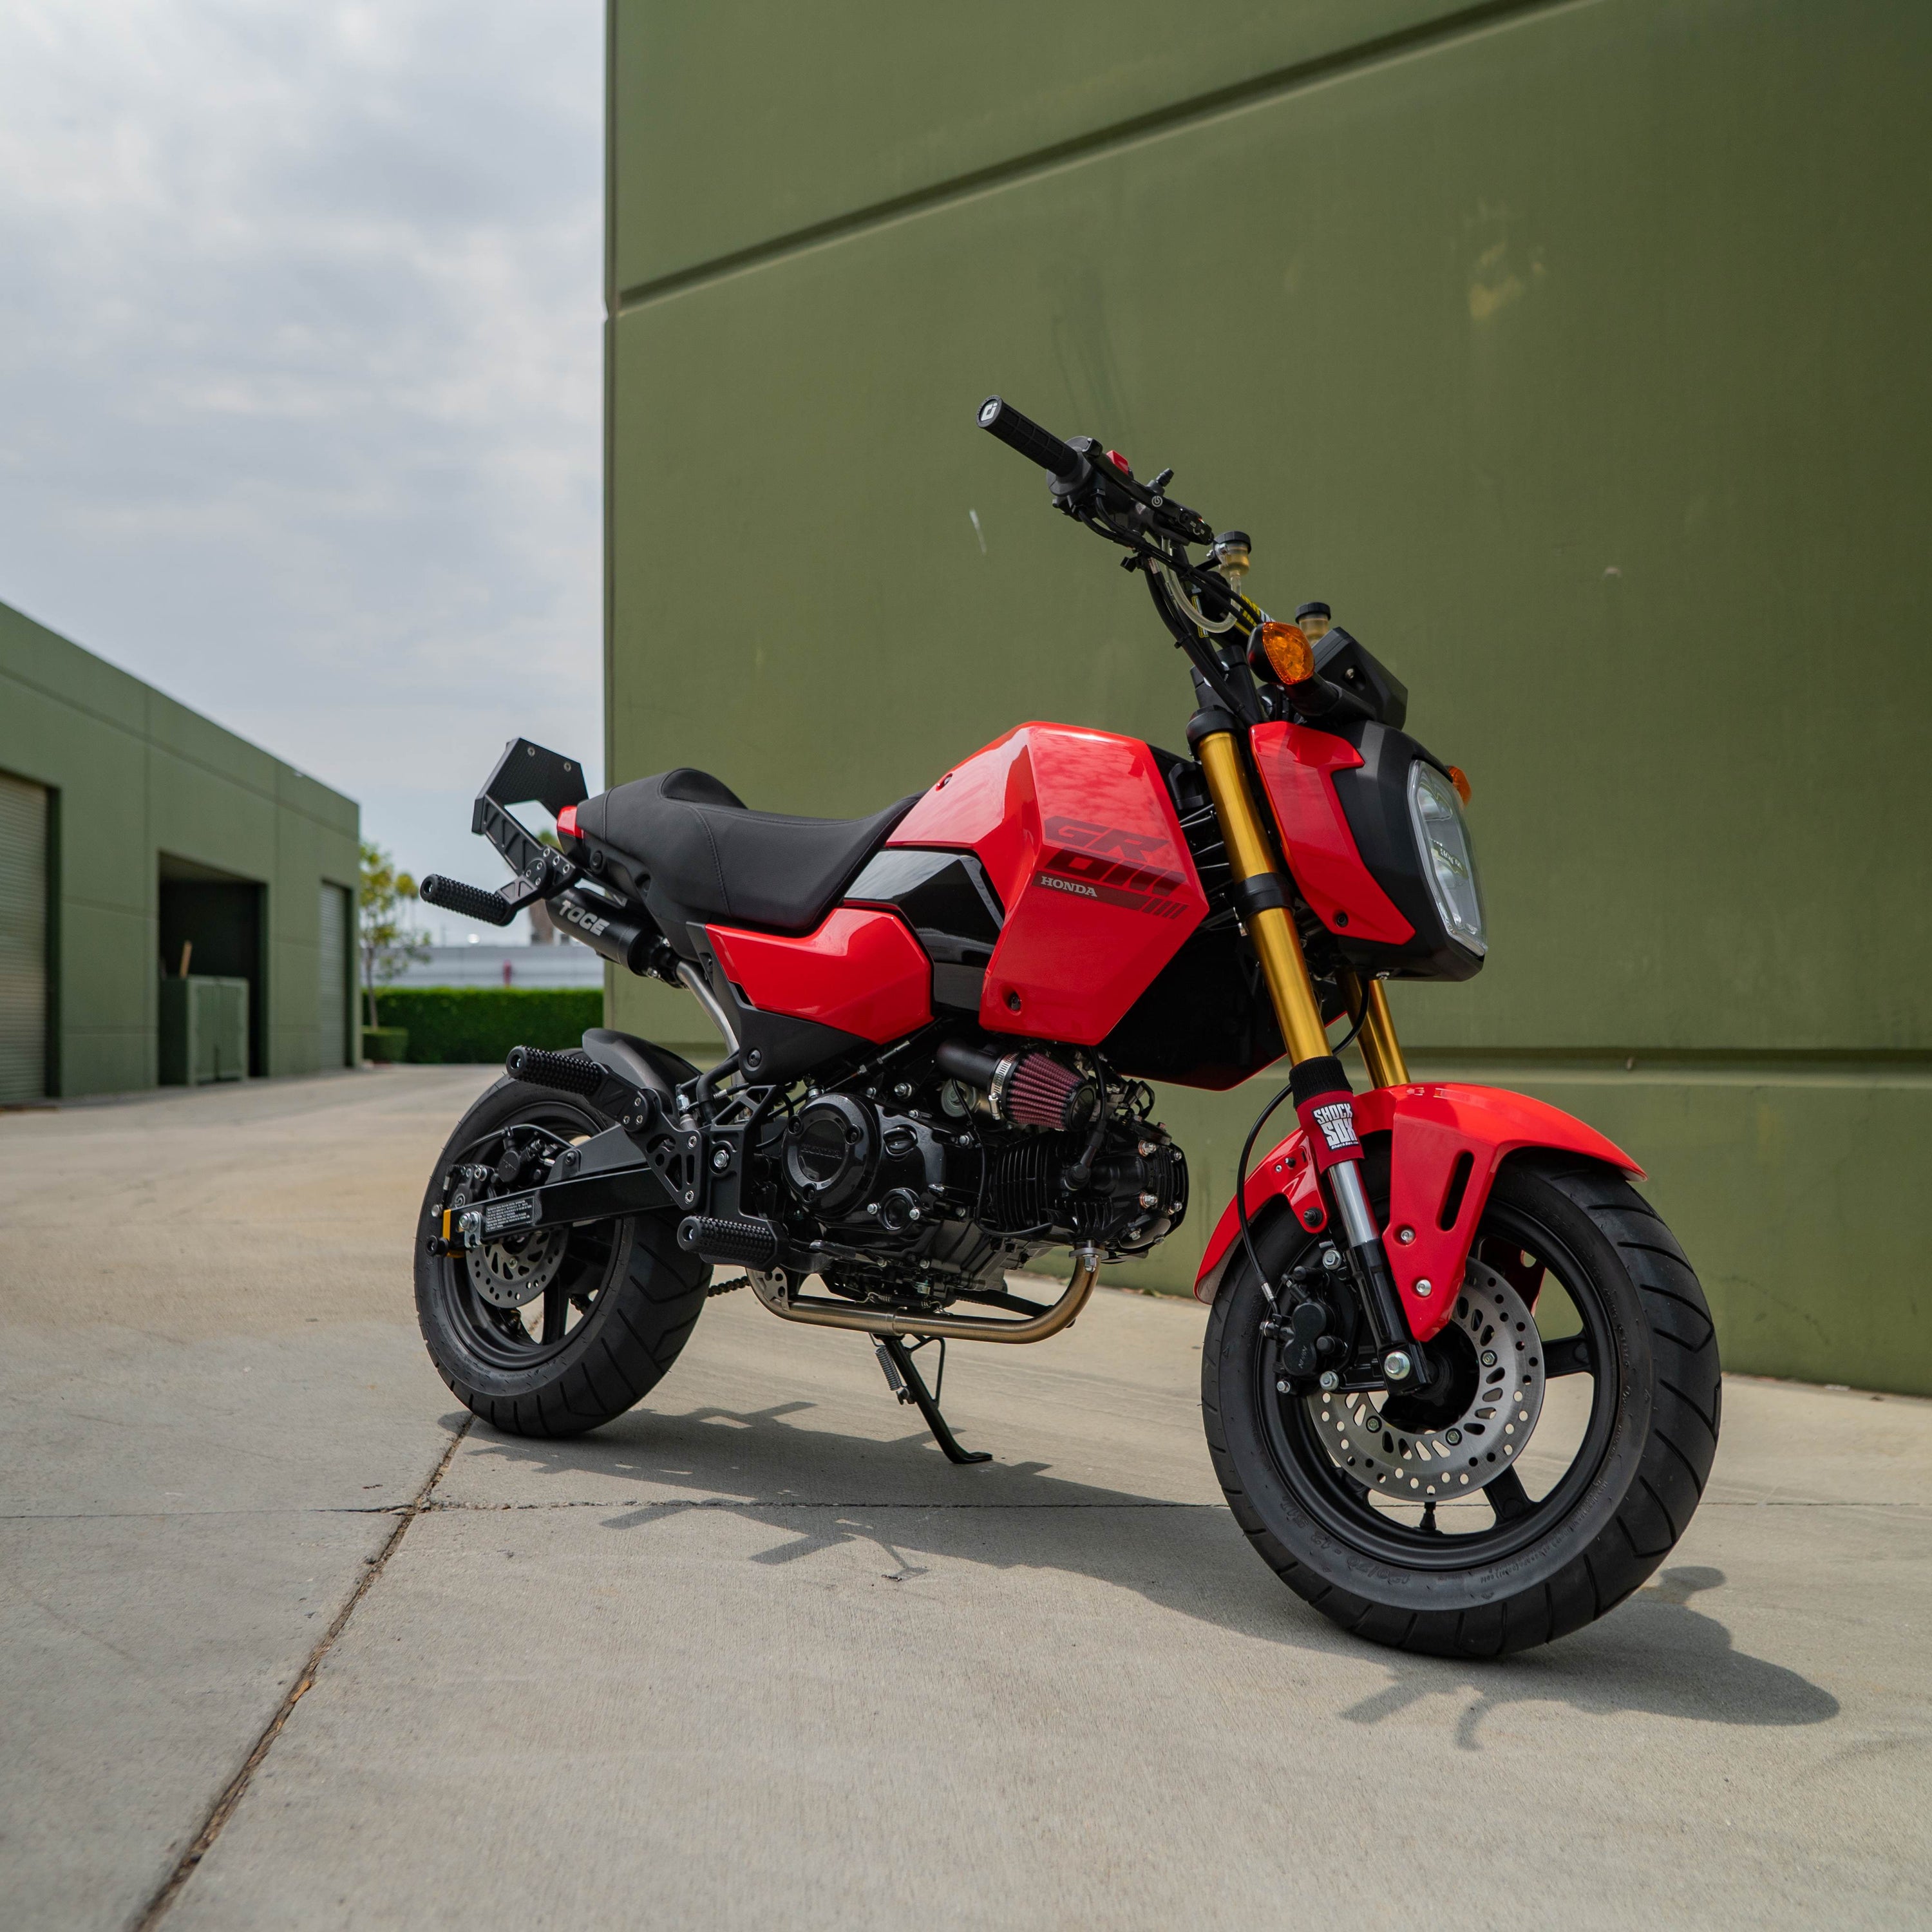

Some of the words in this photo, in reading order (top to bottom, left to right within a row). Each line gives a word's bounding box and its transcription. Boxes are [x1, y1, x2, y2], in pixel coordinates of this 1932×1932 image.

[1043, 815, 1170, 862] GR
[1041, 876, 1098, 897] HONDA
[559, 900, 610, 936] TOCE
[1313, 1103, 1353, 1124] SHOCK
[1320, 1117, 1358, 1146] SOX
